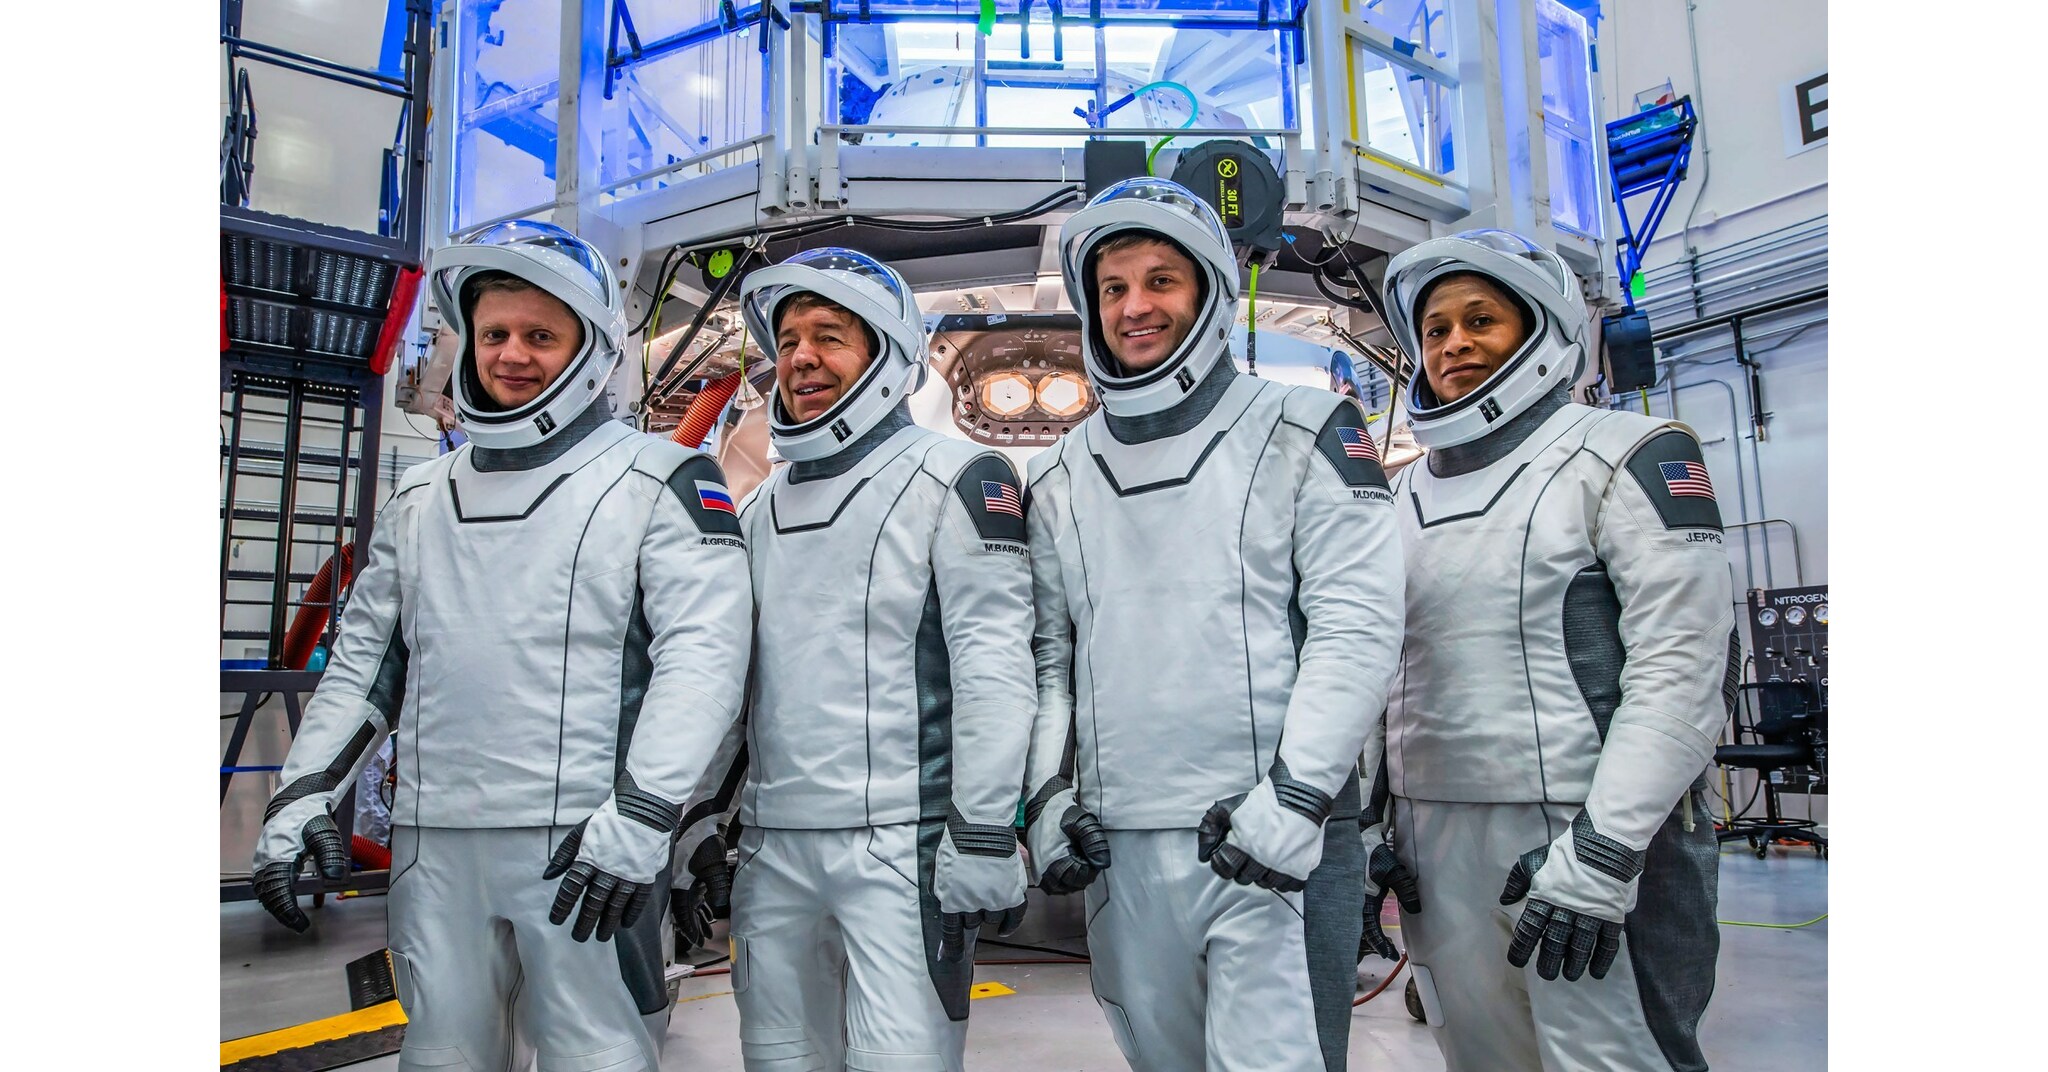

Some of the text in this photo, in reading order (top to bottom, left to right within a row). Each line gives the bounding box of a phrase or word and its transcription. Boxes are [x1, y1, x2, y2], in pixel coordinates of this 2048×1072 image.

[1227, 189, 1239, 216] 30 FT
[1685, 532, 1722, 544] J.EPPS
[1774, 592, 1828, 606] NITROGEN
